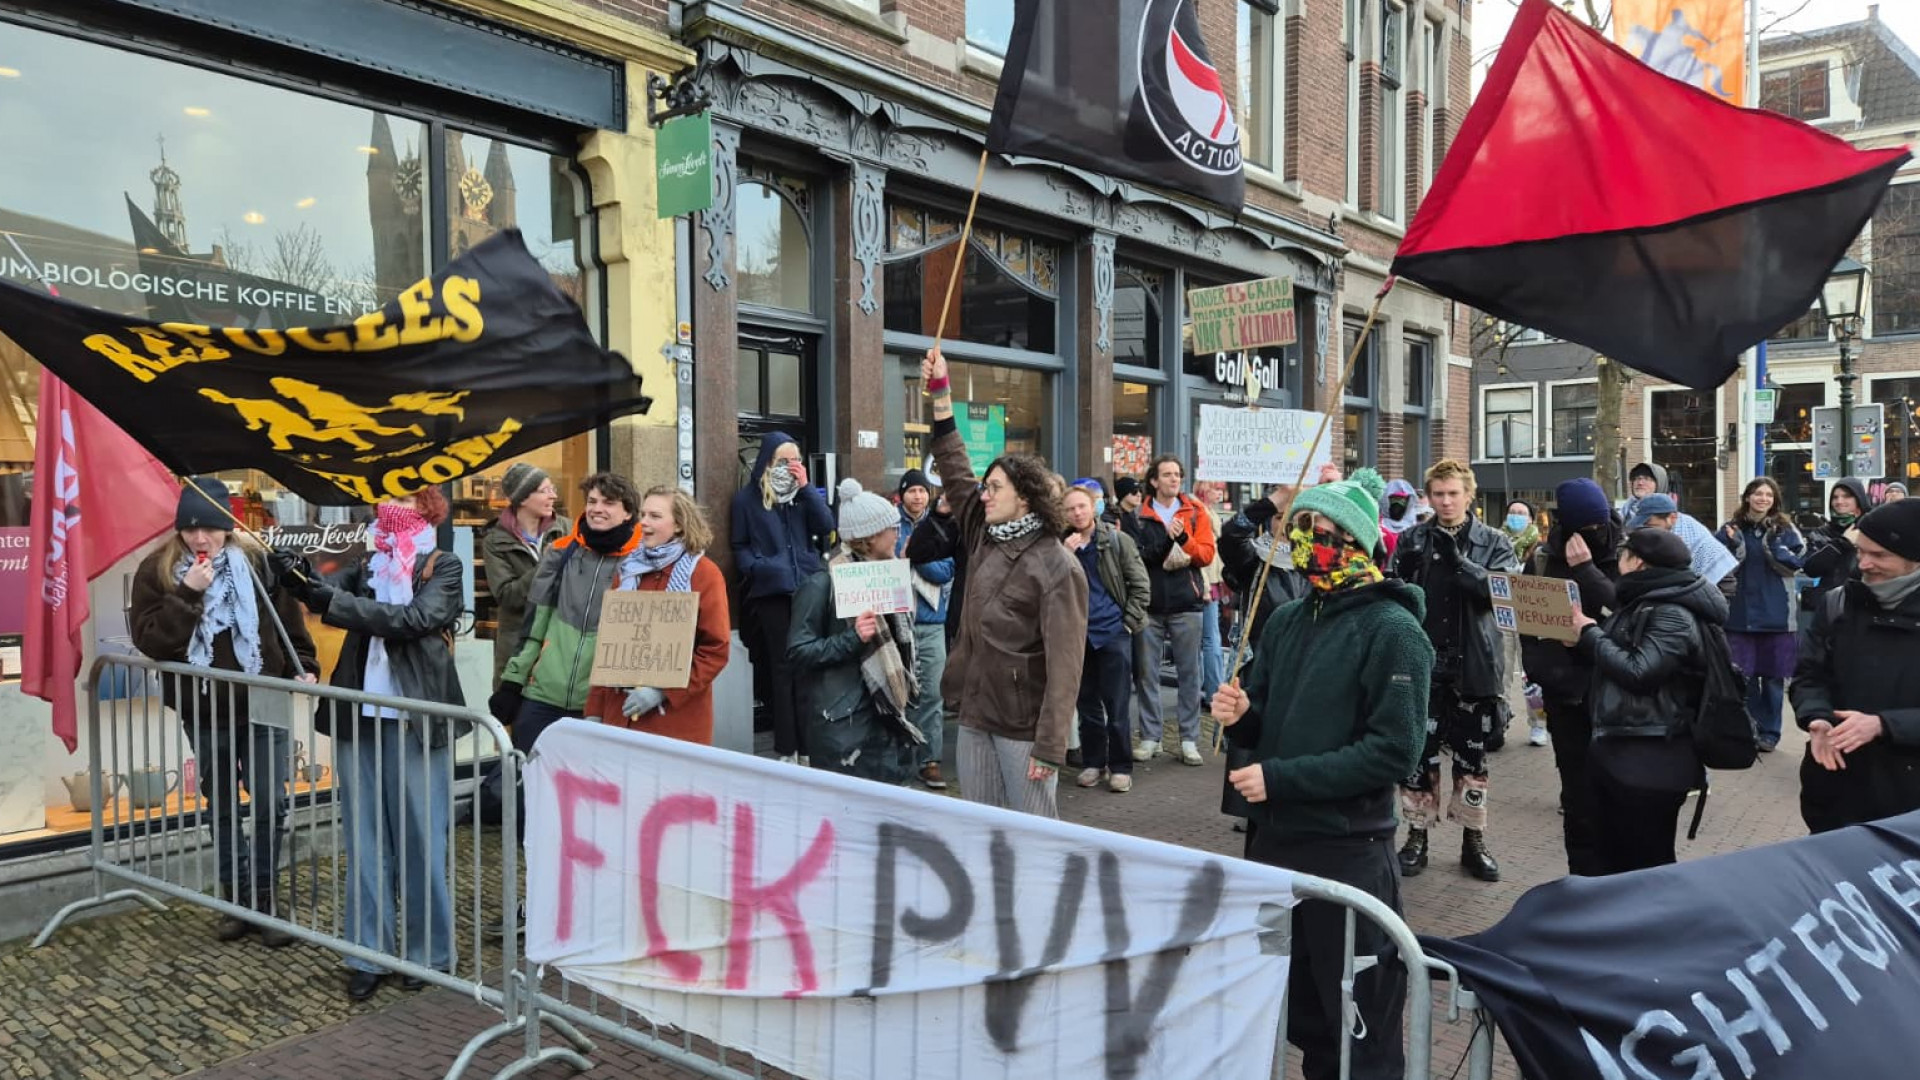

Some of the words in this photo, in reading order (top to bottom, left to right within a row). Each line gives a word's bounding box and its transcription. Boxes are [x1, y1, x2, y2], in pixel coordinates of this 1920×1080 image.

[1175, 131, 1240, 168] ACTION
[44, 261, 229, 303] BIOLOGISCHE
[238, 285, 316, 313] KOFFIE
[325, 297, 353, 316] EN
[1193, 287, 1225, 308] ONDER
[82, 275, 484, 383] REFUGEES
[1215, 352, 1245, 387] Gall
[1253, 355, 1280, 390] Gall
[260, 524, 320, 549] Simon
[605, 601, 644, 623] GEEN
[648, 599, 693, 622] MENS
[632, 623, 652, 642] IS
[597, 642, 683, 673] ILLEGAAL
[552, 767, 837, 999] FCK
[853, 821, 1226, 1080] PVV
[1791, 880, 1903, 1006] FOR
